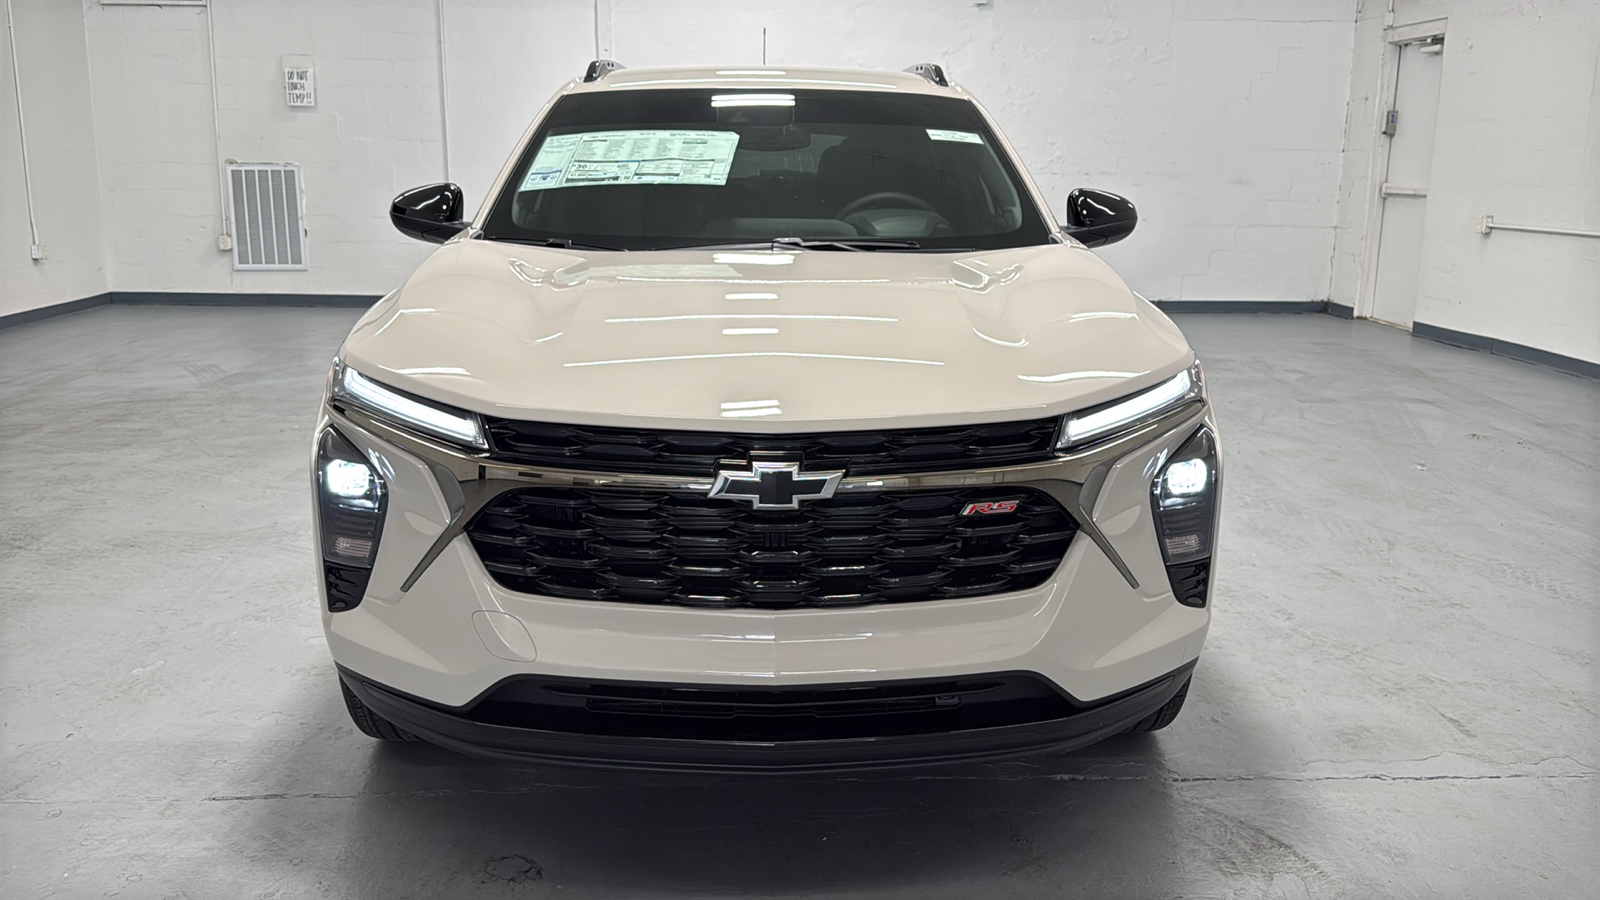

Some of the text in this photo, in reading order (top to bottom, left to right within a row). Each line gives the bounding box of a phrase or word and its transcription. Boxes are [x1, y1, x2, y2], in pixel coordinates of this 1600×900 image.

[287, 70, 309, 82] DO NOT
[287, 81, 305, 92] TOUCH
[287, 92, 312, 104] TEMP!!
[962, 500, 1020, 515] RS
